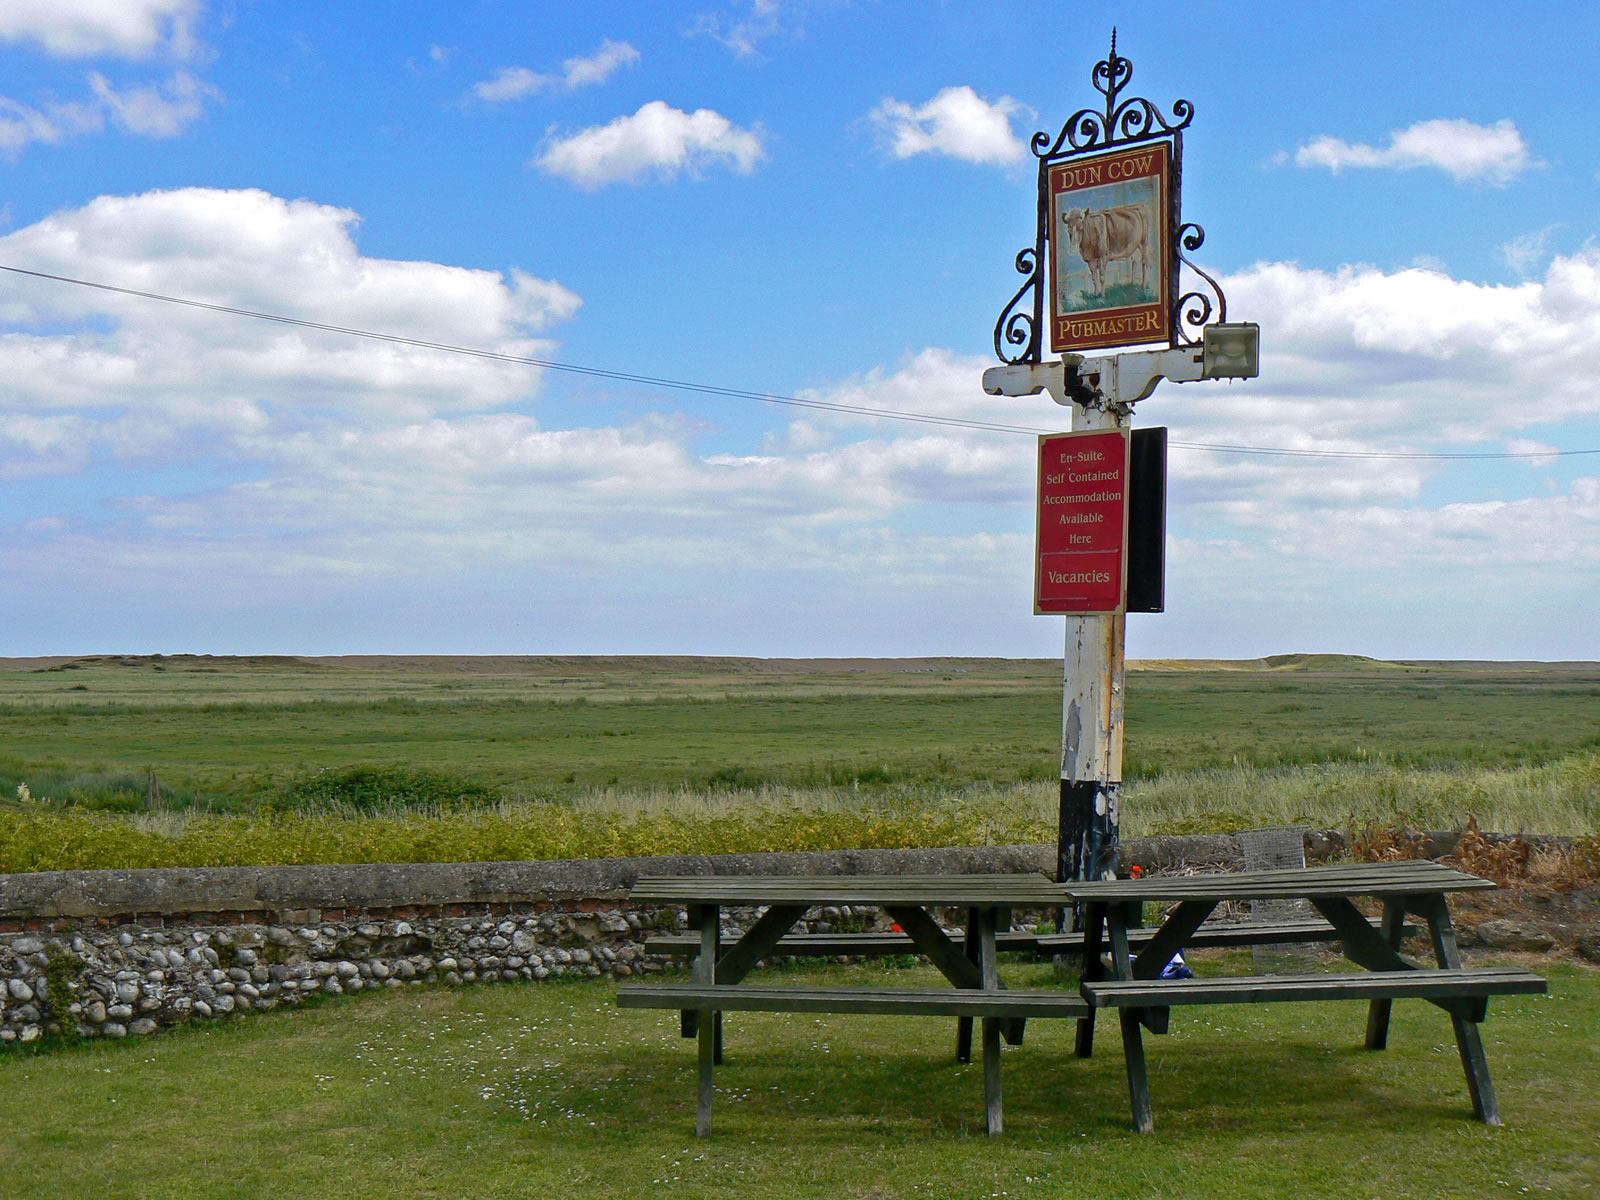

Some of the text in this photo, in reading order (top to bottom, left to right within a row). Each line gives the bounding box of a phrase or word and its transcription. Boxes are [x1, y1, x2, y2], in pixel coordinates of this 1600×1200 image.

[1061, 155, 1154, 189] DUN COW
[1058, 310, 1160, 340] PUBMASTER
[1046, 469, 1119, 485] Self Contained
[1043, 490, 1121, 505] Accommodation
[1059, 512, 1104, 525] Available
[1069, 534, 1092, 545] Here
[1048, 569, 1110, 584] Vacancies
